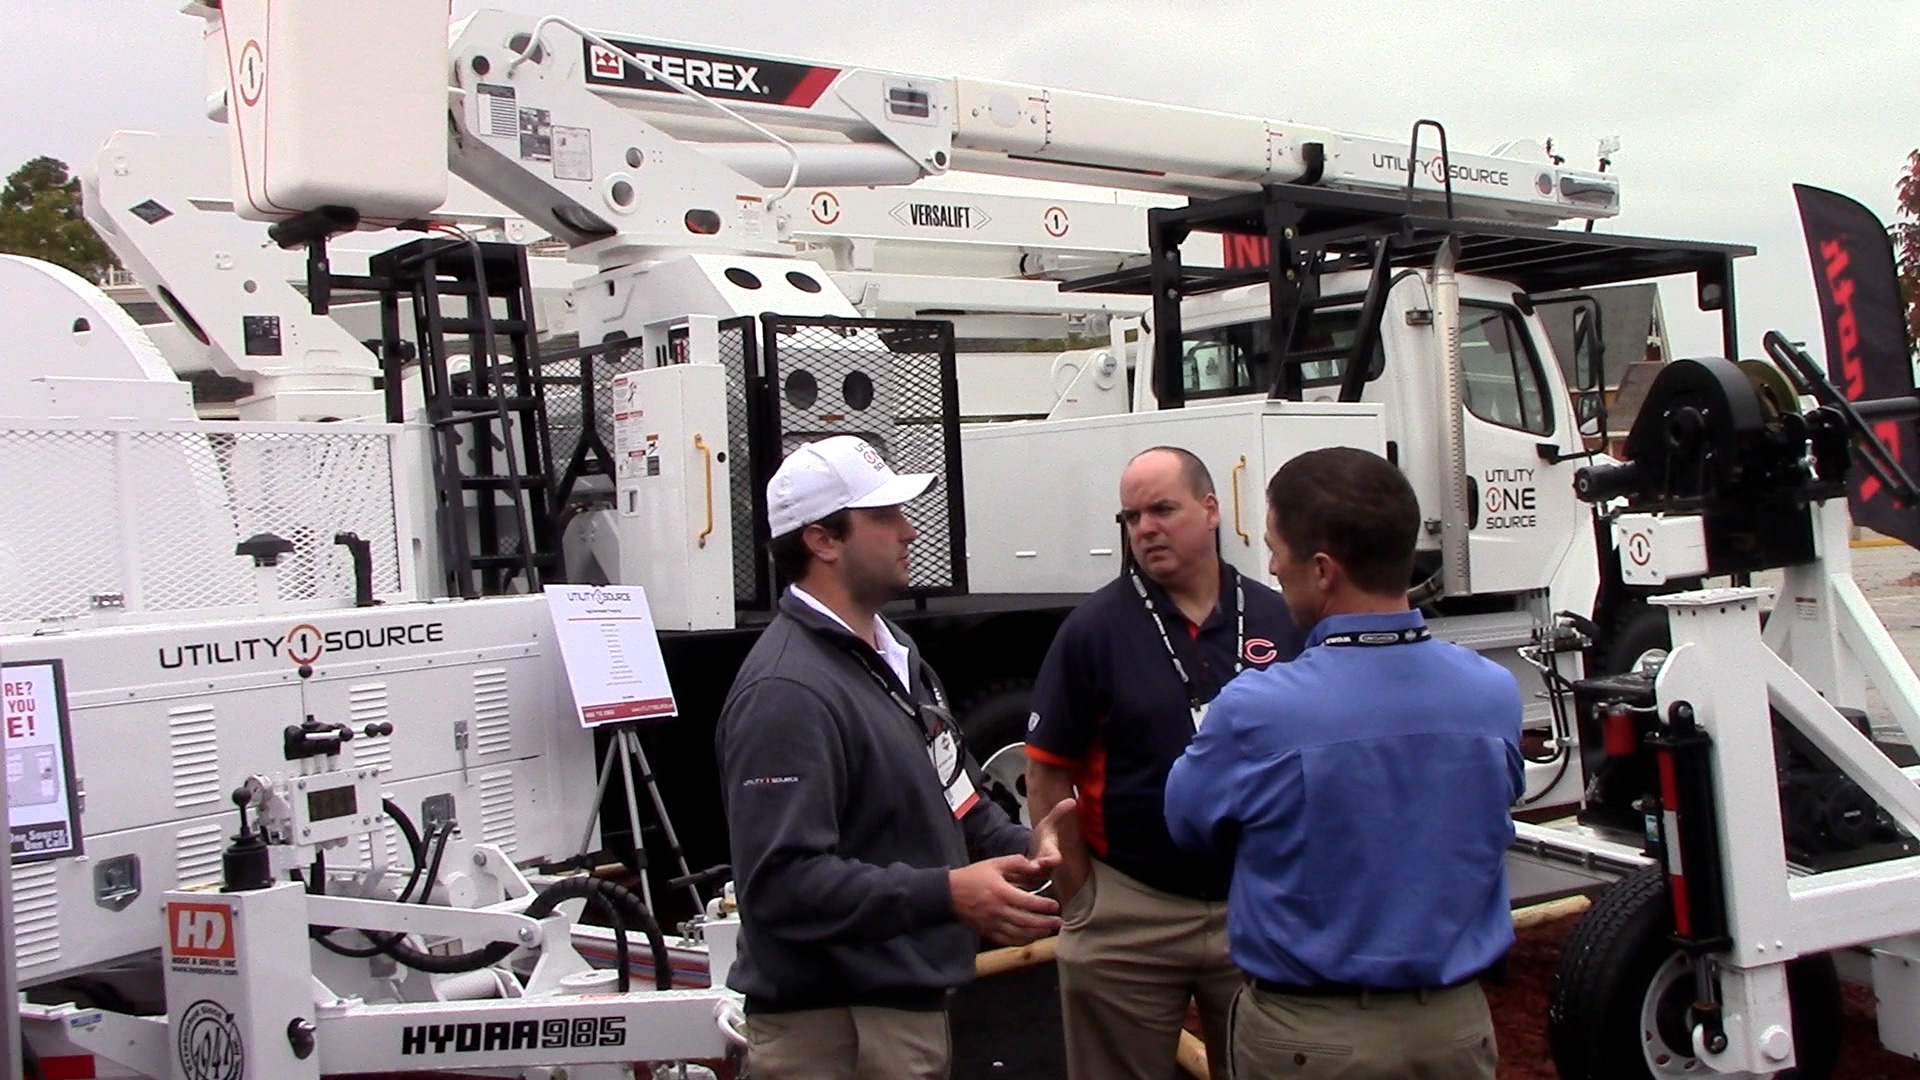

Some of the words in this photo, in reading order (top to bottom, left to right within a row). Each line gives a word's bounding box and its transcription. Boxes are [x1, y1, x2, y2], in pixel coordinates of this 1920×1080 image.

[636, 53, 760, 94] TEREX
[1373, 153, 1430, 174] UTILY
[1448, 165, 1508, 186] SOURCE
[910, 204, 970, 228] VERSALIFT
[1485, 469, 1534, 482] UTILITY
[1485, 487, 1535, 513] ONE
[1486, 515, 1536, 529] SOURCE
[601, 592, 631, 601] SOURCE
[159, 636, 285, 668] UTILITY
[325, 623, 443, 652] SOURCE
[7, 699, 36, 712] YOU
[178, 910, 226, 950] HD
